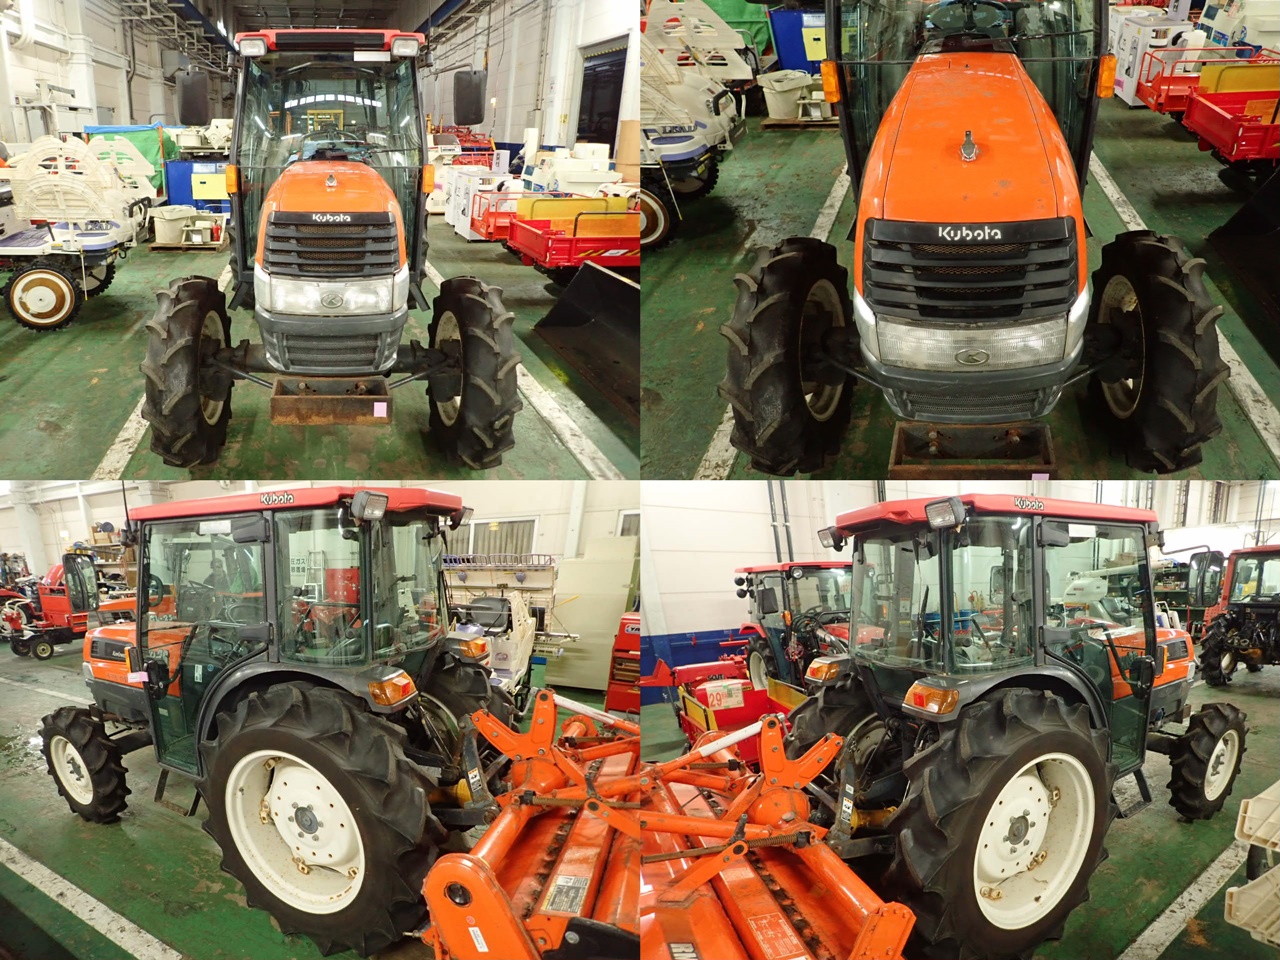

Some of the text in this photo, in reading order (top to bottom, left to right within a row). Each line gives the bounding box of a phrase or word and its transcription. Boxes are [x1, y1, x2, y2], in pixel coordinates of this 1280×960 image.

[312, 213, 351, 222] Kubota
[938, 225, 1002, 241] Kubota
[260, 491, 294, 505] Kubota
[1014, 496, 1044, 511] Kubota
